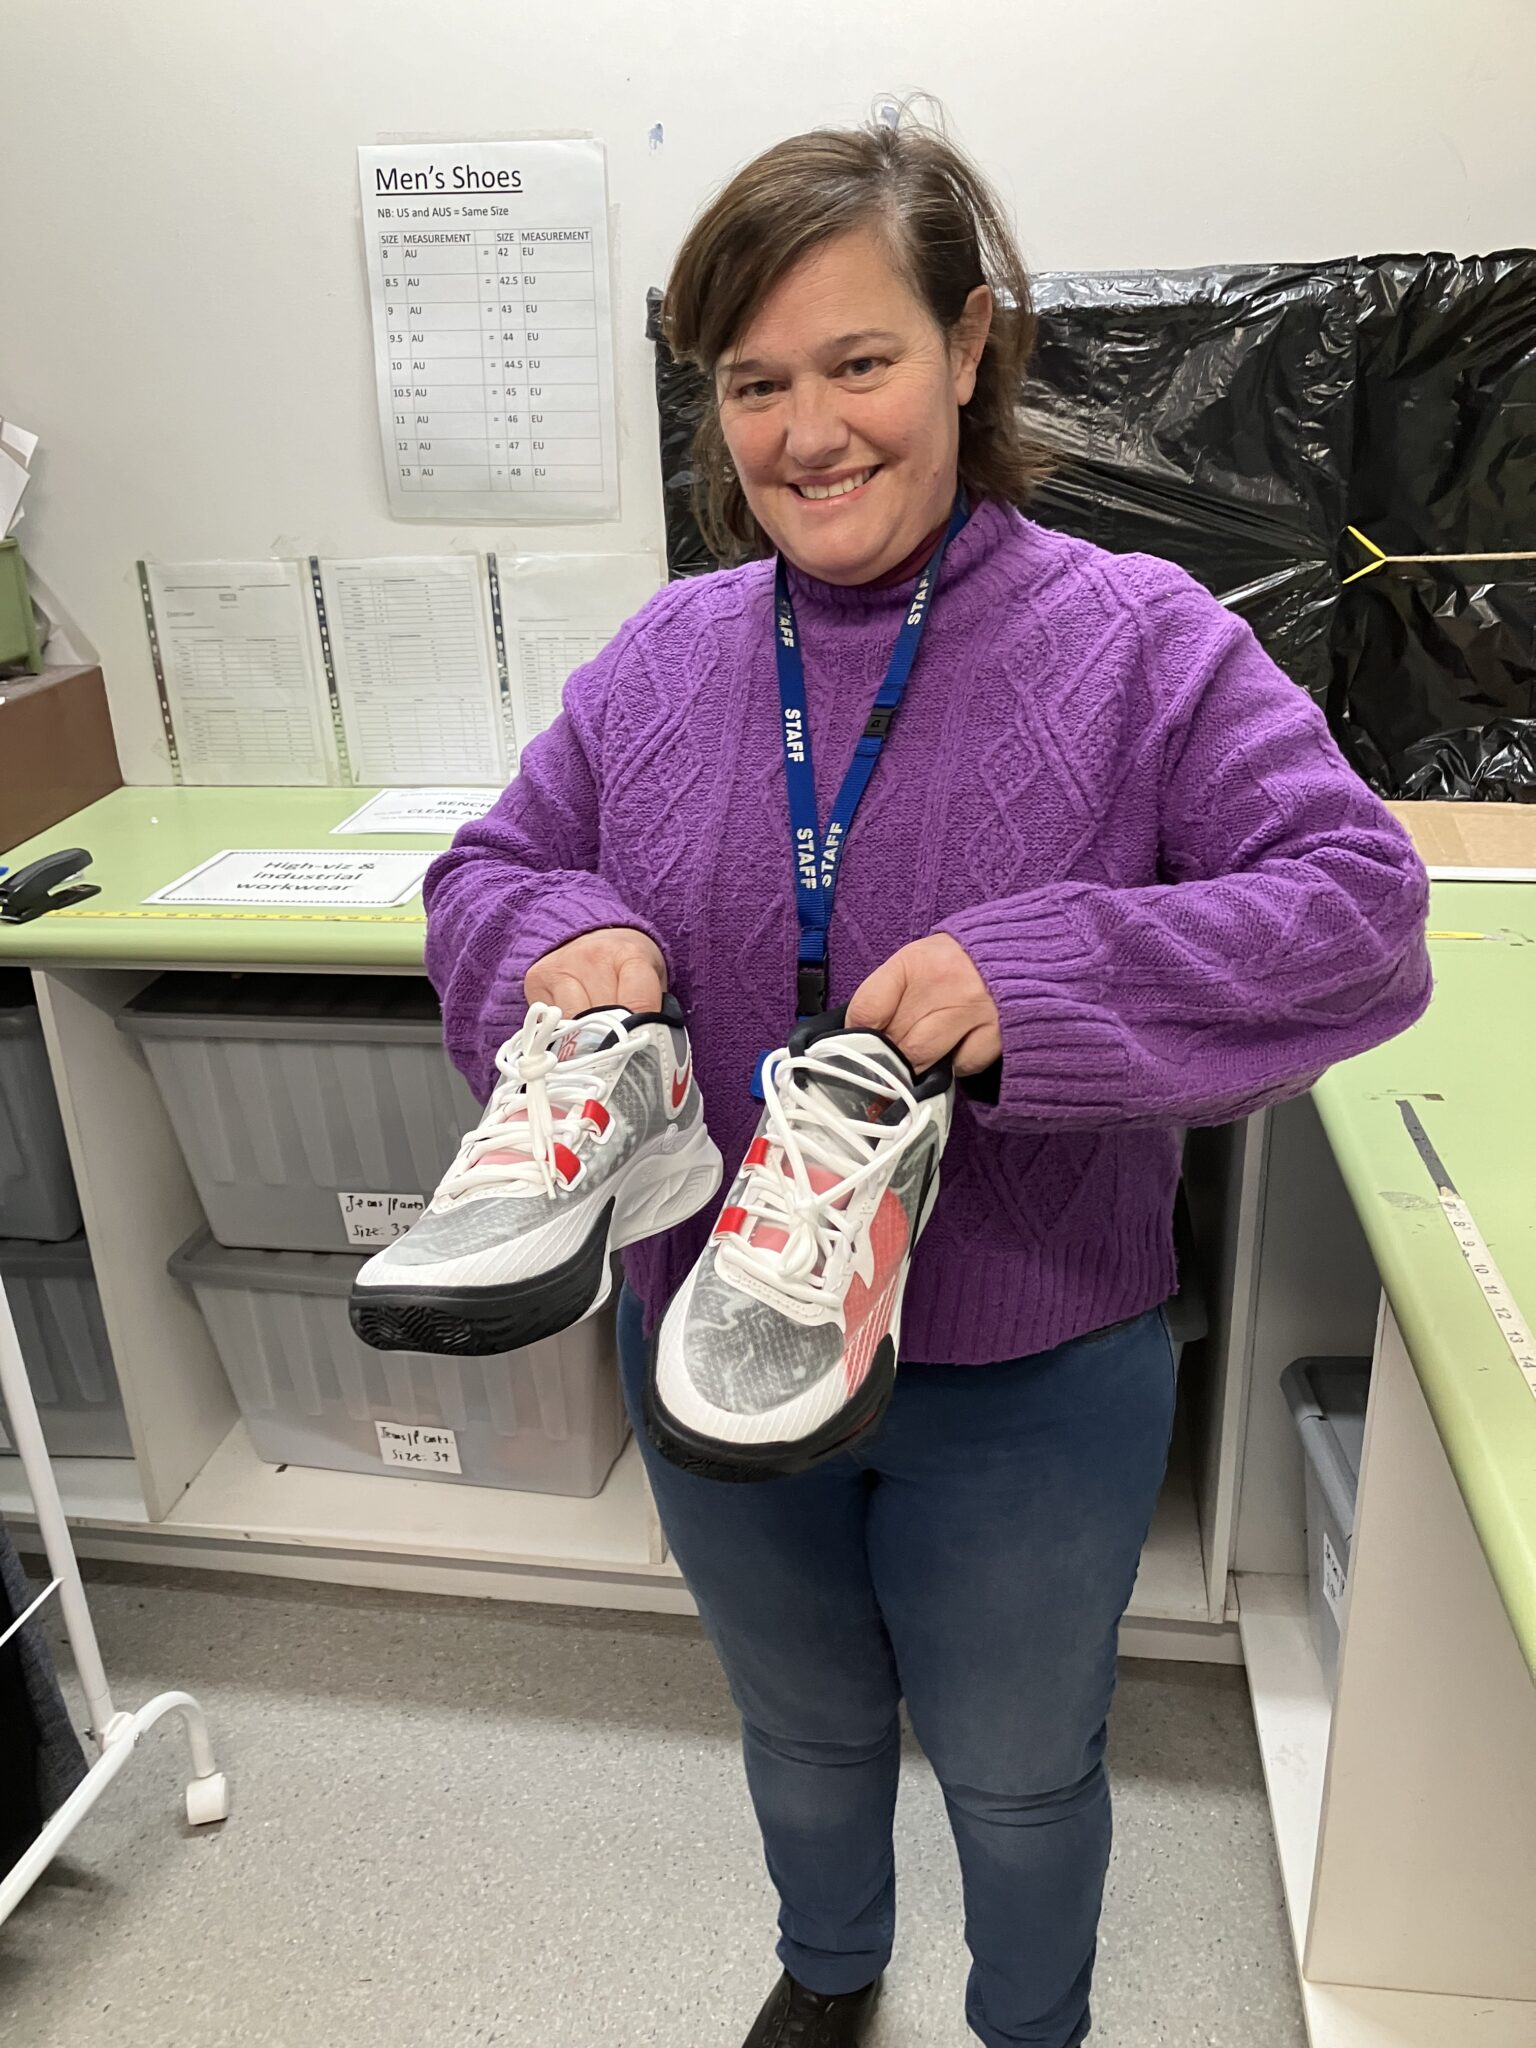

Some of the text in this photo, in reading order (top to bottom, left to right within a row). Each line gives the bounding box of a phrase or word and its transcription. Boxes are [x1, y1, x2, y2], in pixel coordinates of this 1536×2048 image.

[376, 165, 522, 190] Men's Shoes
[378, 208, 394, 218] NB:
[397, 207, 410, 217] US
[412, 207, 430, 217] and
[432, 206, 452, 217] AUS
[462, 206, 488, 216] Same
[490, 206, 509, 216] Size
[381, 231, 589, 244] SIZE MEASUREMENT SIZE MEASUREMENT
[382, 249, 389, 259] 8
[404, 249, 417, 258] AU
[498, 248, 509, 257] 42
[522, 248, 534, 256] EU
[385, 278, 399, 287] 8.5
[407, 278, 420, 287] AU
[500, 276, 518, 285] 42.5
[524, 276, 536, 285] EU
[388, 307, 394, 315] 9
[410, 306, 422, 315] AU
[501, 305, 512, 313] 43
[526, 305, 537, 313] EU
[390, 334, 403, 343] 9.5
[411, 334, 424, 343] AU
[503, 333, 514, 341] 44
[527, 333, 539, 341] EU
[392, 362, 402, 370] 10
[413, 362, 425, 370] AU
[504, 360, 523, 369] 44.5
[529, 360, 540, 369] EU
[393, 388, 411, 397] 10.5
[415, 389, 427, 397] AU
[506, 388, 517, 396] 45
[530, 388, 541, 396] EU
[396, 416, 405, 424] 11
[417, 415, 429, 424] AU
[507, 415, 518, 423] 46
[531, 415, 543, 423] EU
[398, 442, 408, 450] 12
[419, 442, 431, 450] AU
[509, 442, 519, 450] 47
[533, 442, 544, 450] EU
[401, 468, 411, 477] 13
[422, 468, 434, 476] AU
[510, 468, 521, 477] 48
[534, 468, 546, 476] EU
[784, 708, 805, 763] STAFF
[797, 828, 817, 889] STAFF
[821, 822, 843, 888] STAFF
[264, 861, 375, 870] High-viz &
[236, 883, 353, 891] workwear
[1474, 1264, 1489, 1274] 10
[1484, 1285, 1500, 1294] 11
[1495, 1307, 1512, 1319] 12
[1507, 1331, 1524, 1343] 13
[1519, 1356, 1536, 1368] 14
